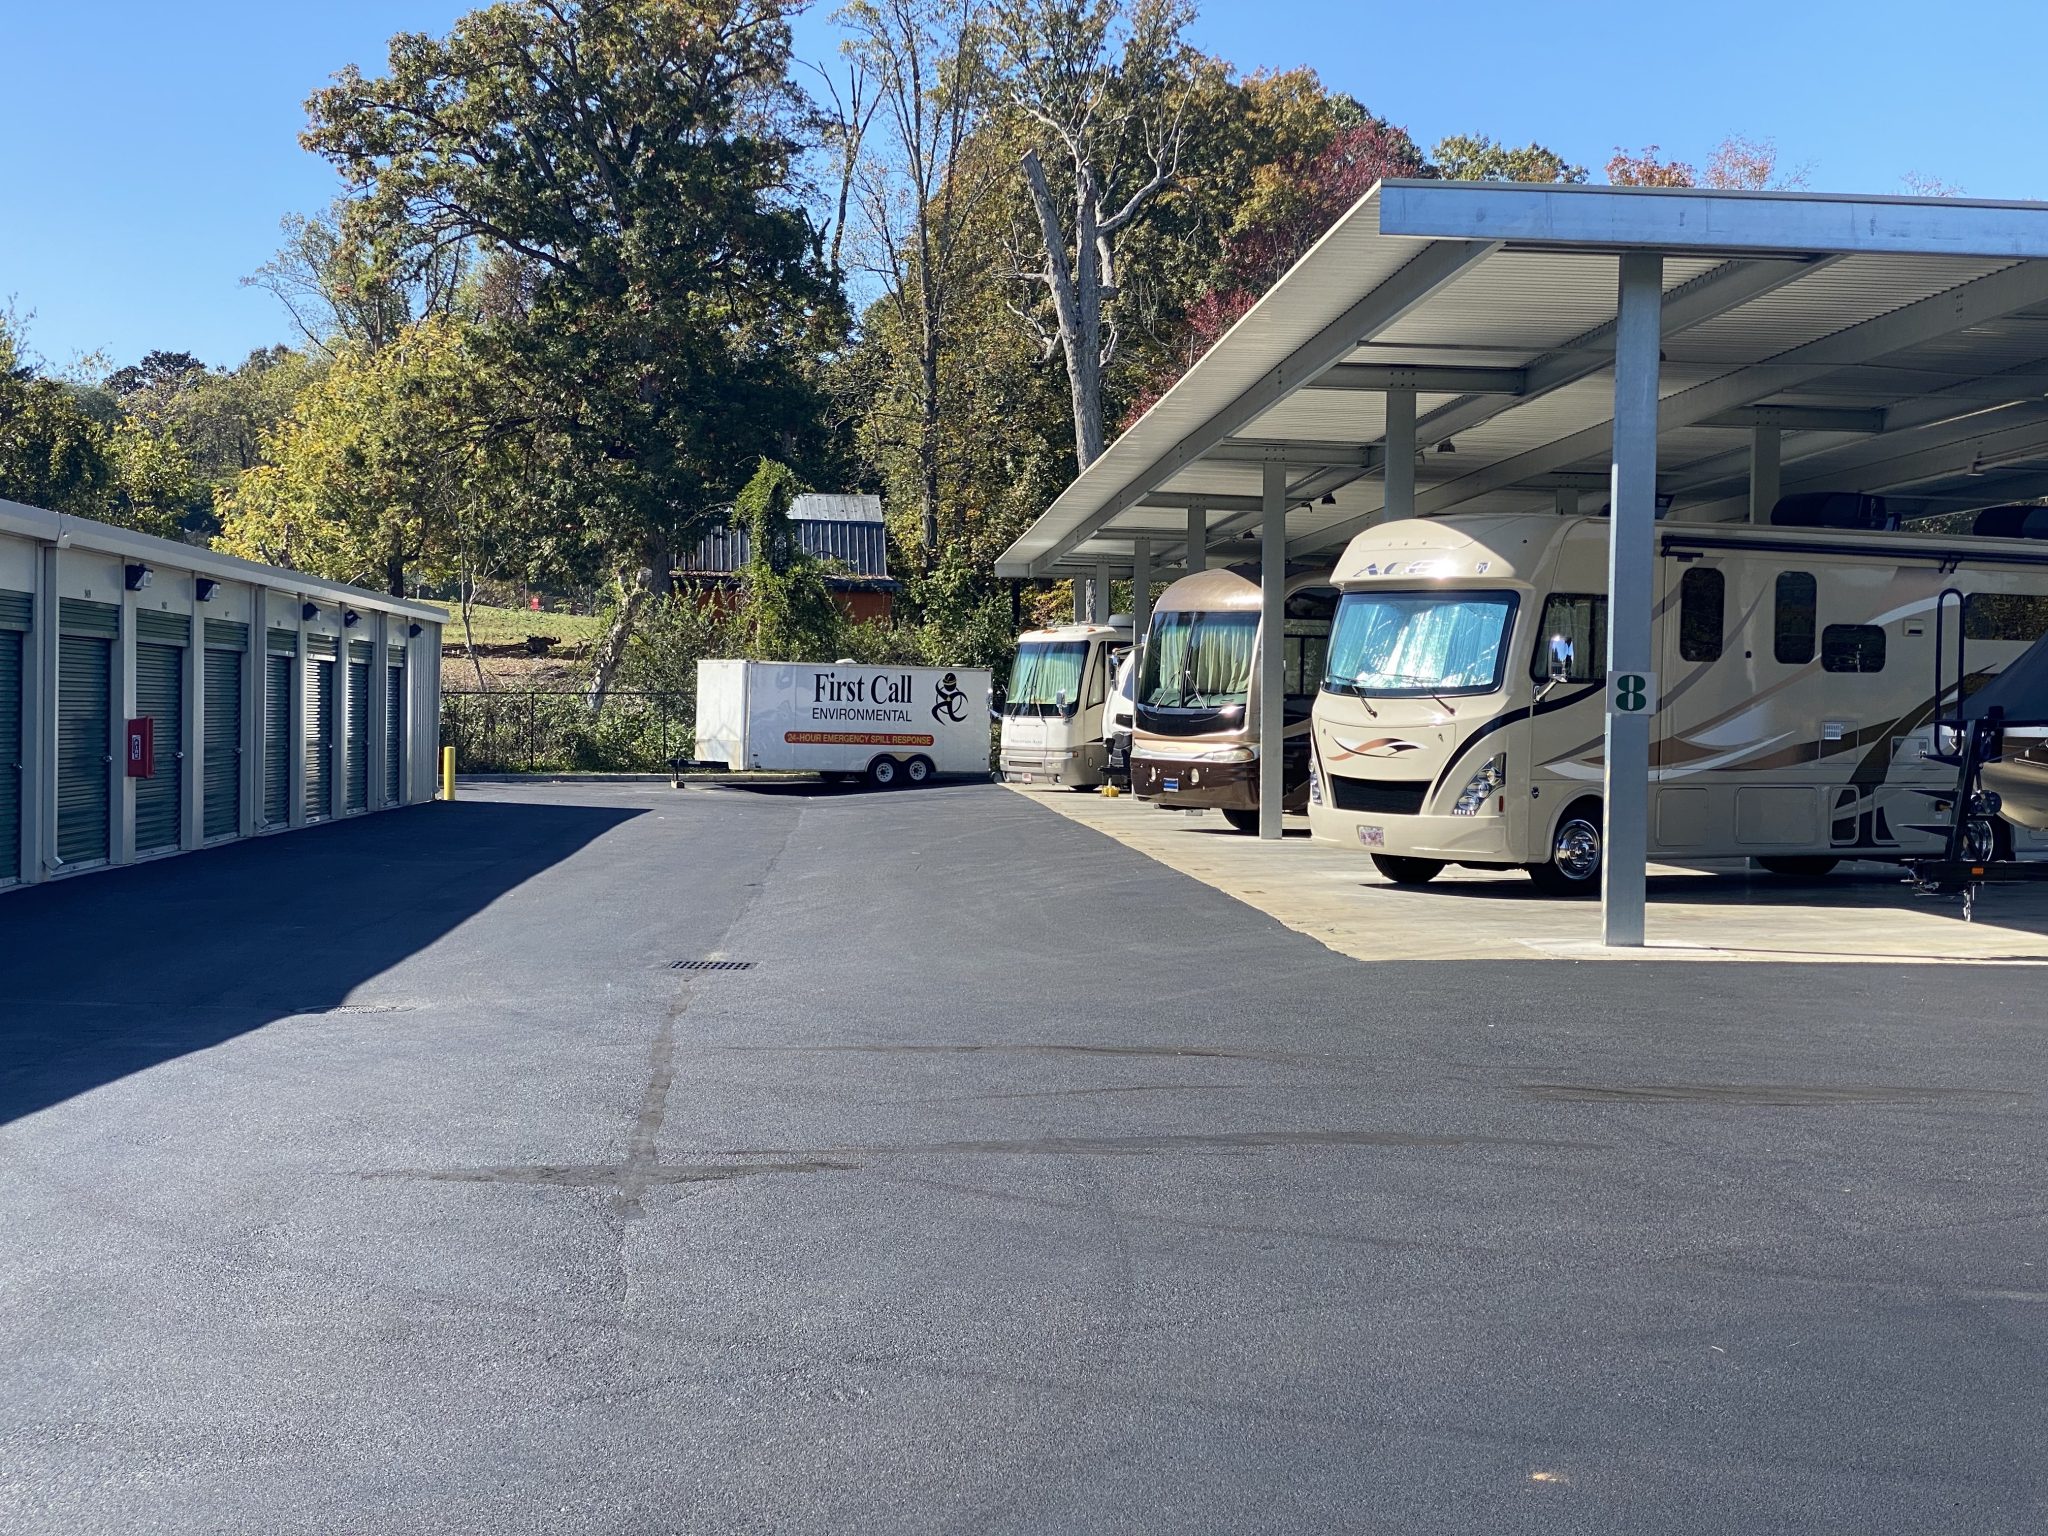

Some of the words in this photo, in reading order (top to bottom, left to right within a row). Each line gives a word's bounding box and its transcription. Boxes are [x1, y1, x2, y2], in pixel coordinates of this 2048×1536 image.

[813, 672, 865, 702] First
[870, 675, 913, 704] Call
[1615, 675, 1646, 711] 8
[812, 707, 912, 722] ENVIRONMENTAL
[787, 733, 822, 742] 24-HOUR
[824, 734, 869, 744] EMERGENCY
[870, 736, 891, 744] SPILL
[892, 737, 931, 745] RESPONSE
